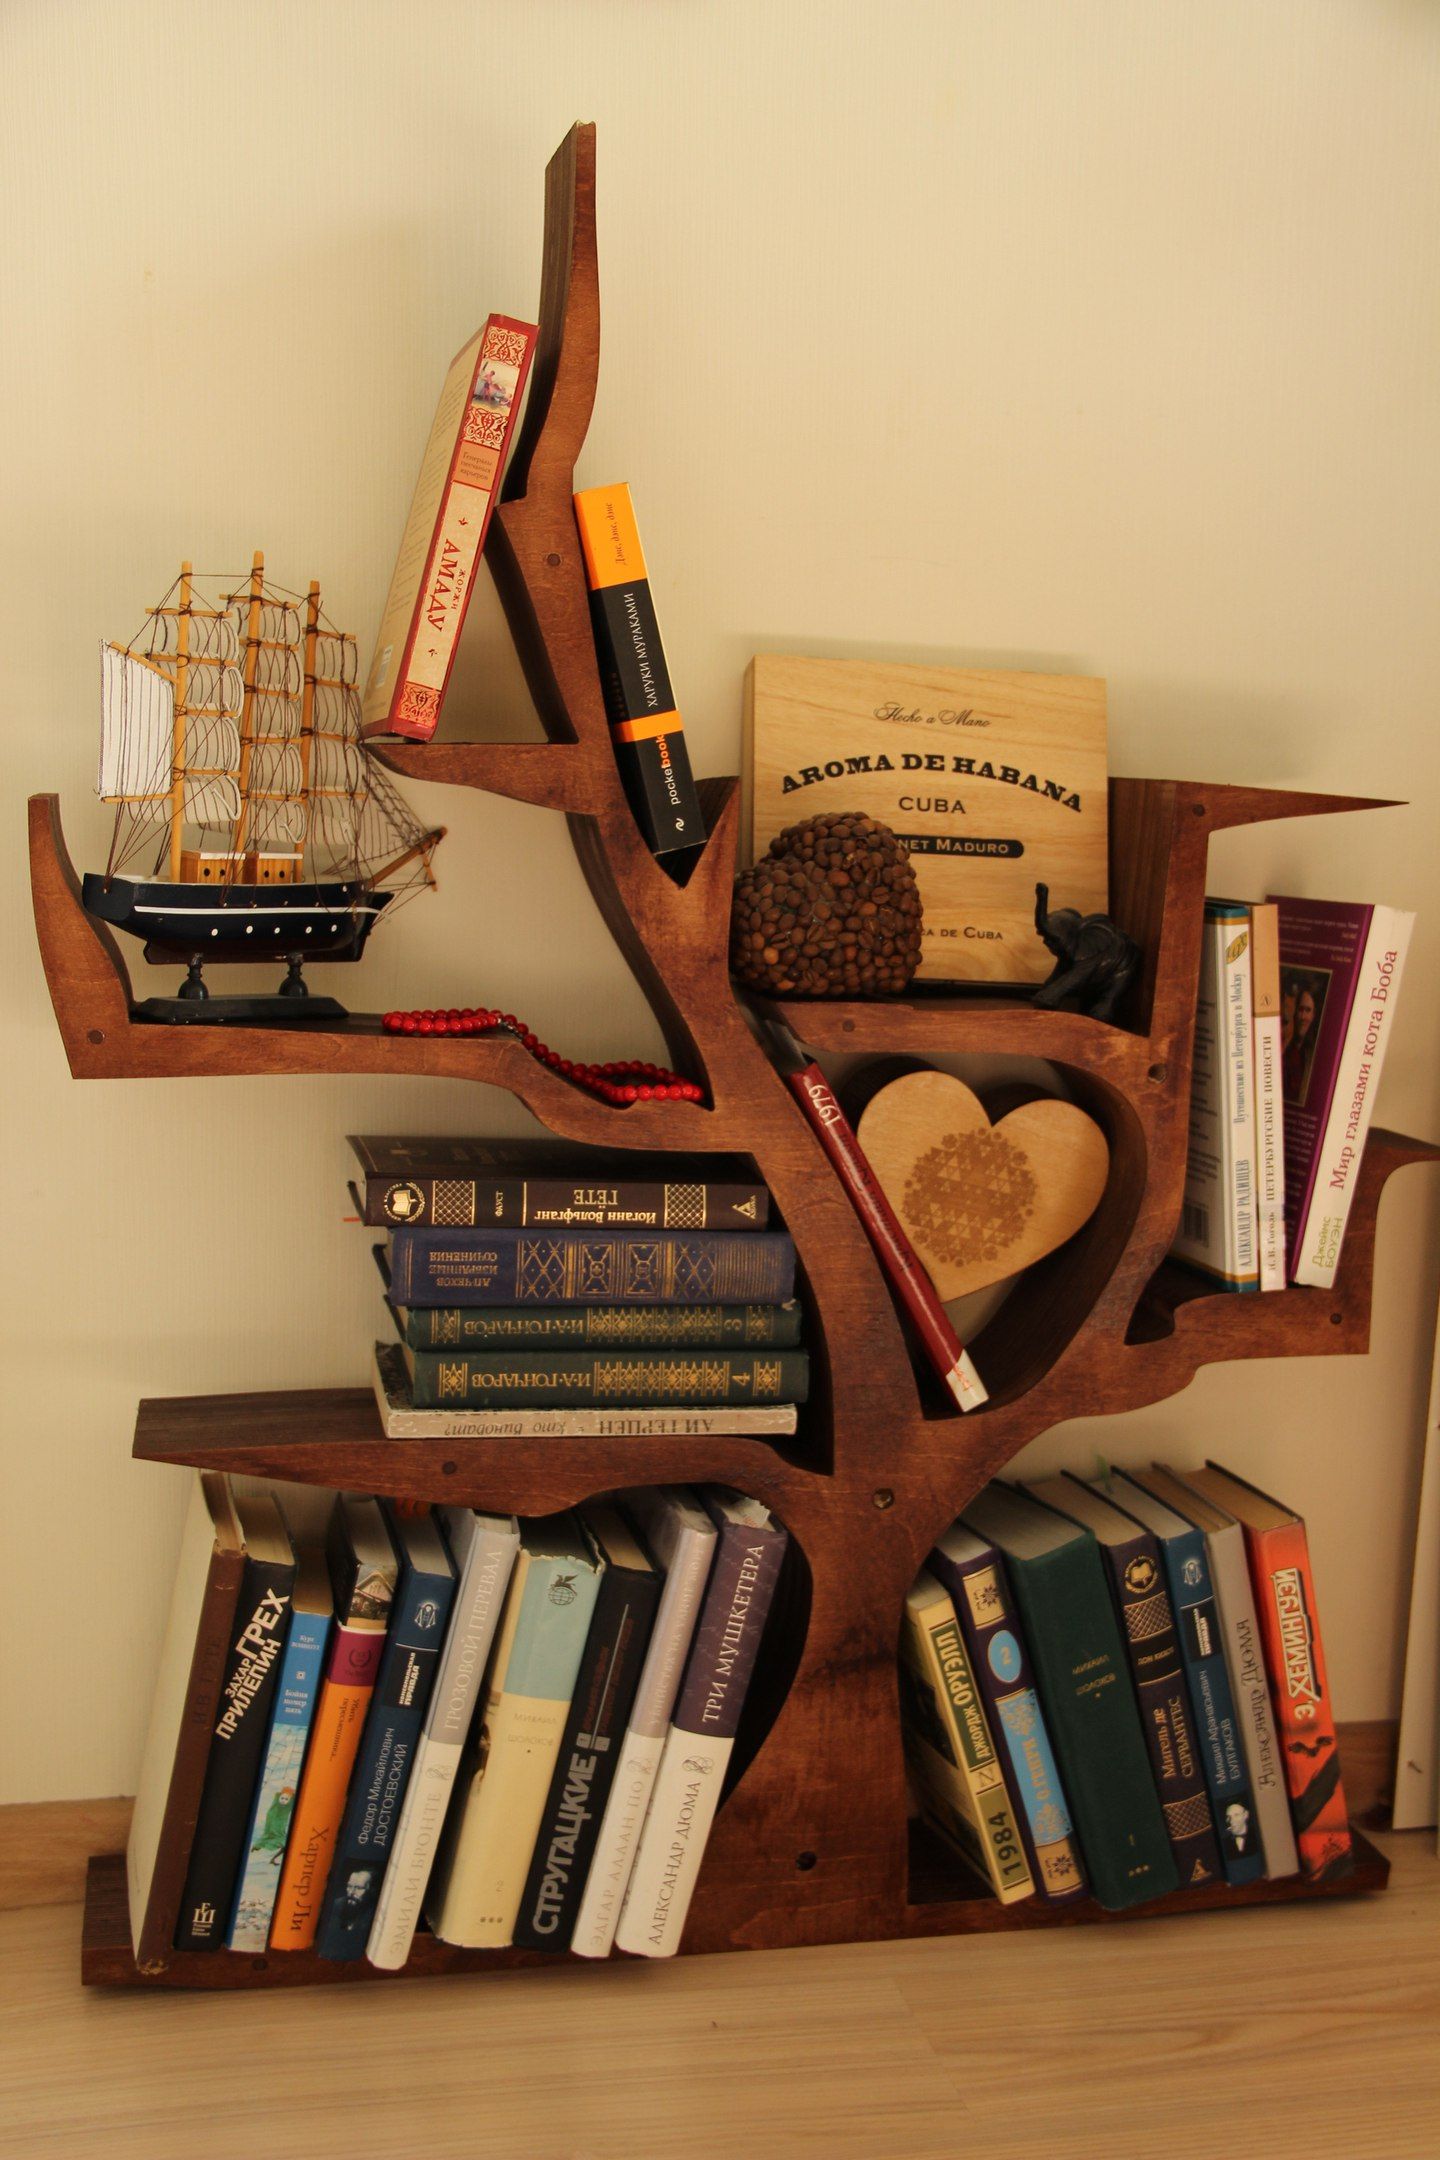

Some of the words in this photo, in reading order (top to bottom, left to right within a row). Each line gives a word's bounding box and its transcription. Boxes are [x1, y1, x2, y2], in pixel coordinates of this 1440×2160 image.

[426, 538, 461, 632] АМАДУ
[451, 569, 466, 610] ЖОРЖИ
[623, 592, 648, 658] МУРАКАМИ
[639, 661, 658, 708] ХАРУКИ
[872, 701, 923, 725] Hecho
[926, 714, 936, 725] a
[938, 708, 992, 729] Mano
[781, 754, 895, 794] AROMA
[901, 753, 945, 771] DE
[952, 756, 1082, 813] HABANA
[898, 796, 967, 815] CUBA
[1370, 950, 1398, 1004] Боба
[1362, 1009, 1385, 1060] кота
[1262, 1035, 1273, 1092] ПОВЕСТИ
[807, 1084, 841, 1127] 1979
[1344, 1062, 1373, 1140] глазами
[1264, 1097, 1275, 1201] ПЕТЕРБУРГСКИЕ
[1329, 1144, 1356, 1190] Мир
[573, 1189, 618, 1209] ГЁТЕ
[1236, 1158, 1250, 1206] РАДИЩЕВ
[534, 1208, 602, 1223] Вольфганг
[604, 1209, 656, 1224] Иоганн
[1235, 1210, 1252, 1267] АЛЕКСАНДР
[1266, 1211, 1276, 1245] Гоголь
[1312, 1215, 1333, 1267] Джеймс
[429, 1250, 498, 1262] СОЧИНЕНИЯ
[1324, 1217, 1343, 1269] БОУЭН
[429, 1265, 498, 1276] ИЗБРАННЫЕ
[731, 1372, 752, 1386] 4
[600, 1419, 676, 1436] ГЕРЦЕН
[236, 1588, 291, 1661] ГРЕХ
[714, 1543, 766, 1678] МУШКЕТЕРА
[1272, 1568, 1318, 1700] ХЕМИНГУЭЙ
[442, 1630, 482, 1732] ГРОЗОВОЙ
[468, 1549, 503, 1630] ПЕРЕВАЛ
[1001, 1647, 1012, 1666] 2
[216, 1638, 282, 1740] ПРИЛЕПИН
[223, 1657, 253, 1699] ЗАХАР
[403, 1664, 420, 1706] ПРАВДА
[936, 1629, 973, 1706] ОРУЭЛЛ
[703, 1678, 730, 1724] ТРИ
[1151, 1707, 1167, 1724] де
[1294, 1699, 1316, 1720] Э.
[962, 1703, 994, 1760] ДЖОРДЖ
[1155, 1726, 1177, 1779] Мигель
[1169, 1695, 1195, 1778] СЕРВАНТЕС
[1219, 1718, 1242, 1782] БУЛГАКОВ
[358, 1799, 378, 1845] Федор
[370, 1726, 395, 1797] Михайлович
[1210, 1742, 1227, 1785] Михаил
[373, 1743, 408, 1847] ДОСТОЕВСКИЙ
[293, 1823, 331, 1897] Харпер
[533, 1753, 599, 1936] СТРУГАЦКИЕ
[589, 1887, 614, 1949] ЭДГАР
[611, 1815, 637, 1883] АЛЛАН
[626, 1780, 645, 1809] ПО
[650, 1838, 686, 1946] АЛЕКСАНДР
[677, 1781, 702, 1840] ДЮМА
[987, 1810, 1022, 1876] 1984
[389, 1876, 421, 1954] ЭМИЛИ
[410, 1790, 443, 1870] БРОНТЕ
[289, 1899, 311, 1932] Ли
